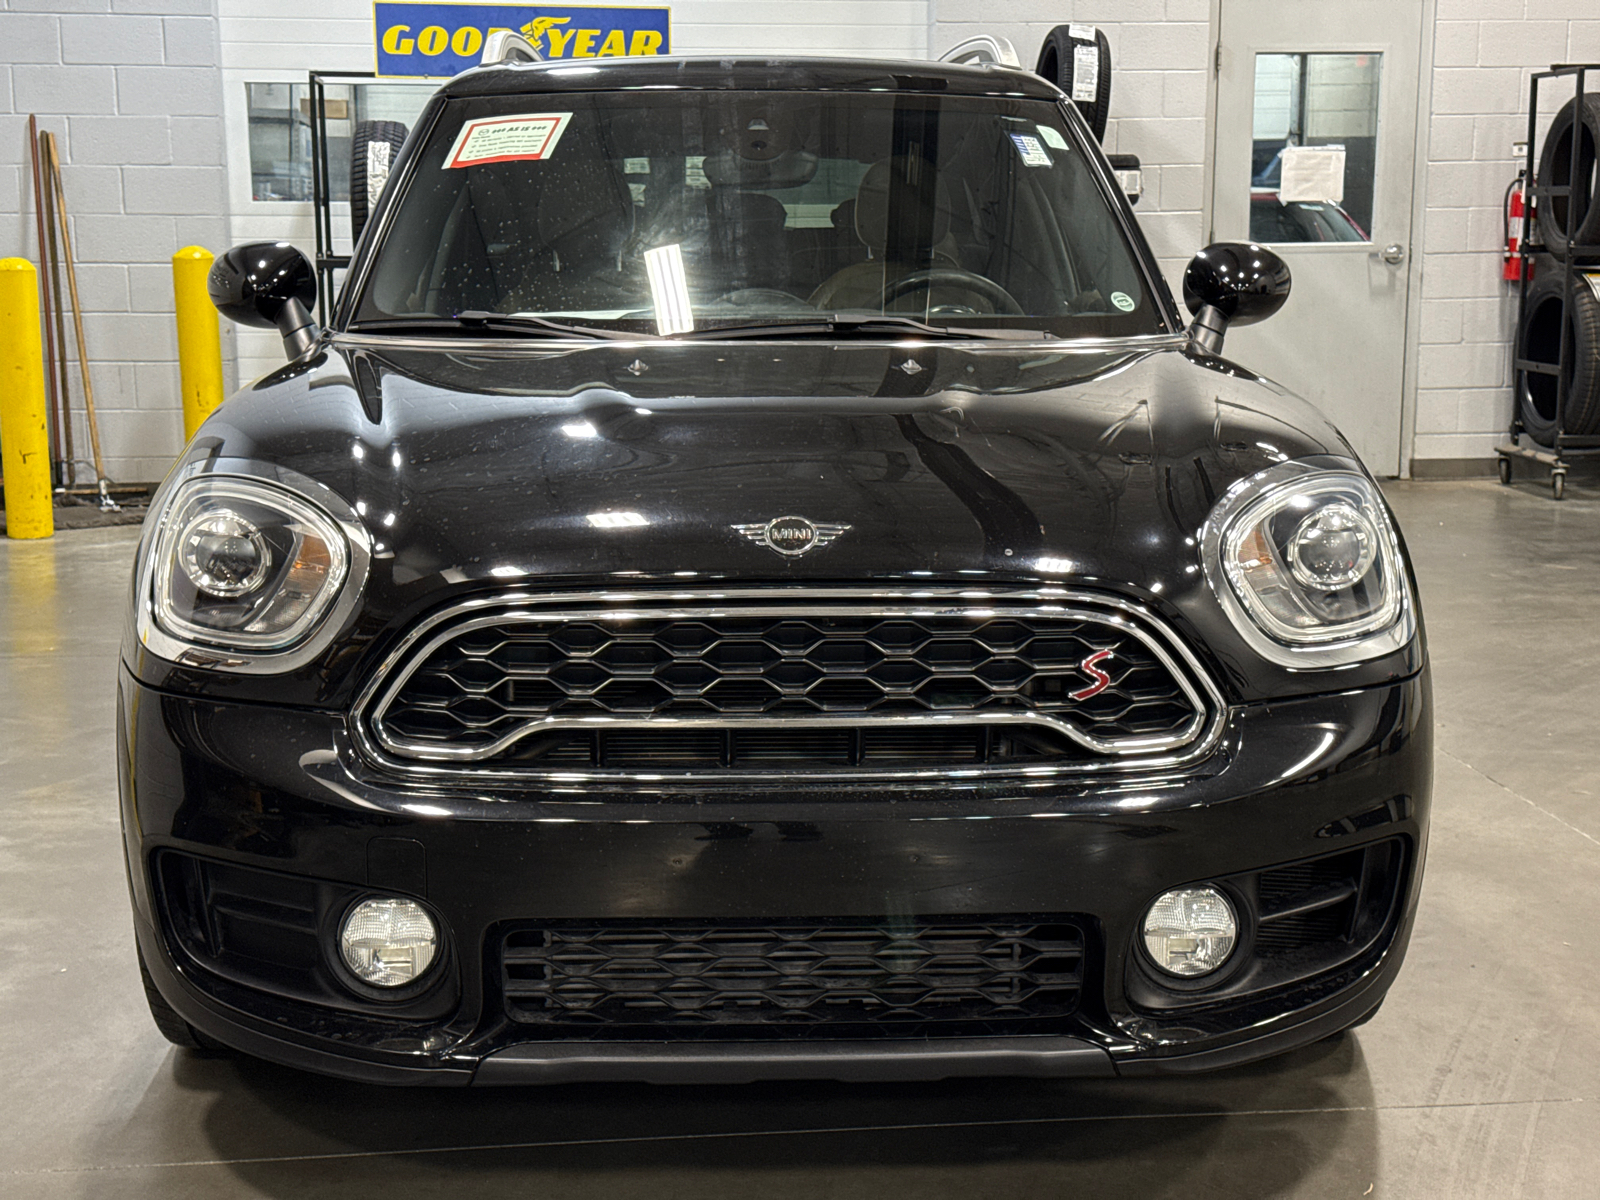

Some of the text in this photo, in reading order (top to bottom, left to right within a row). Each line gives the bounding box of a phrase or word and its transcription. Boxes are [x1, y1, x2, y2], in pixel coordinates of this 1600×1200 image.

[382, 25, 514, 56] GOO
[771, 528, 812, 540] MINI
[1067, 649, 1114, 701] S
